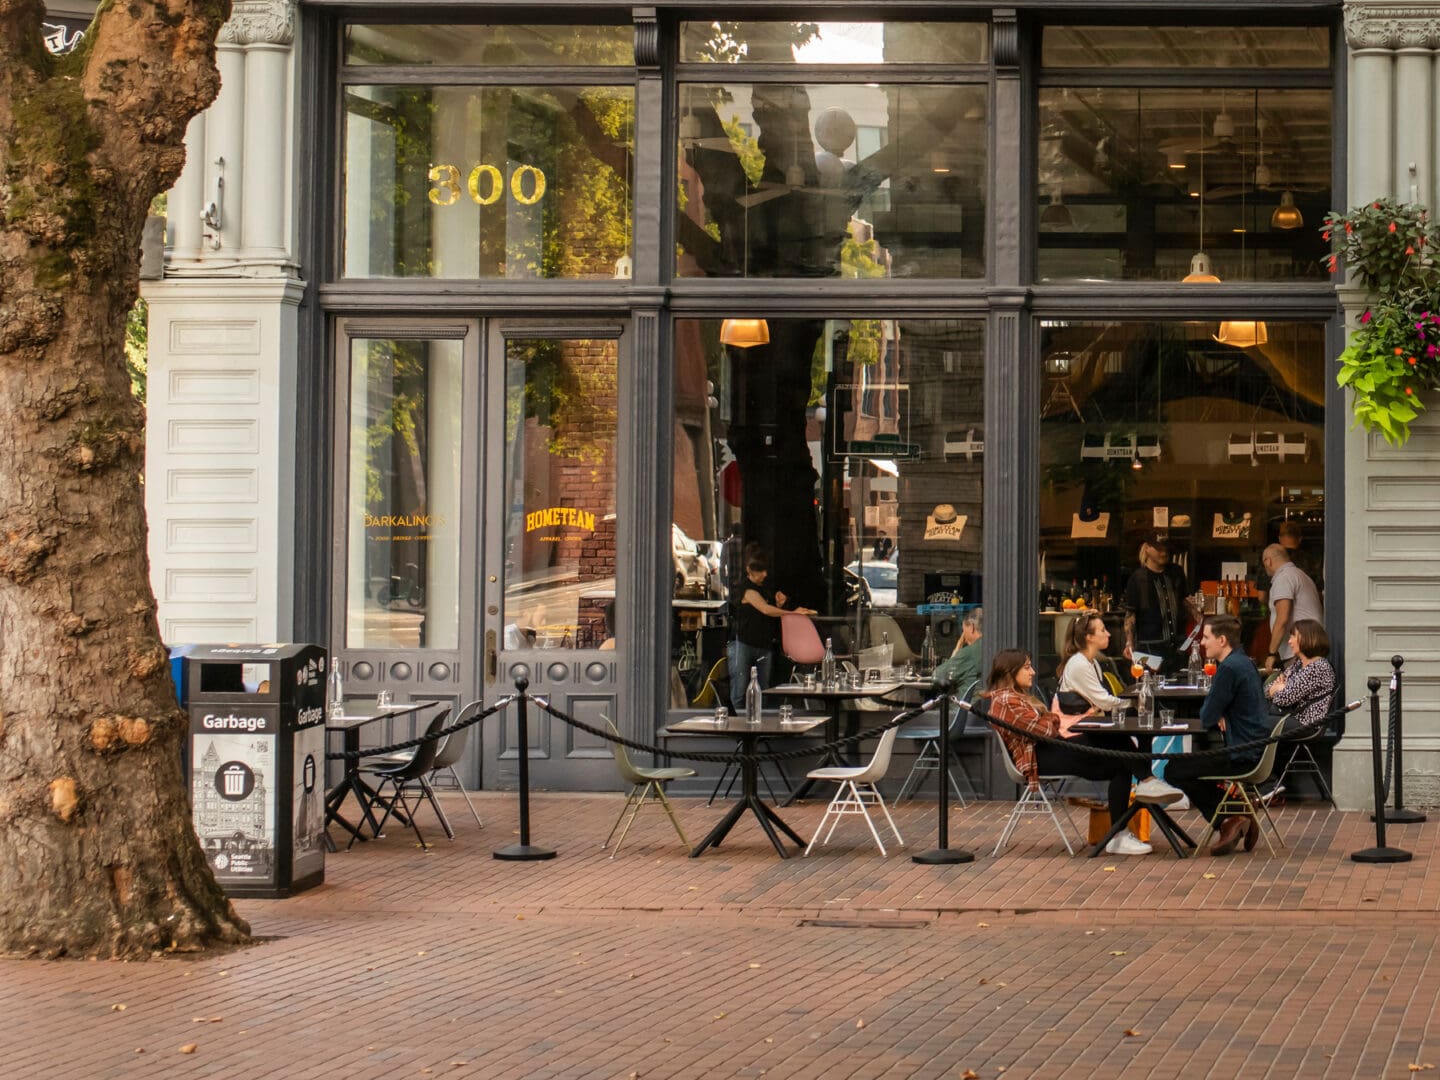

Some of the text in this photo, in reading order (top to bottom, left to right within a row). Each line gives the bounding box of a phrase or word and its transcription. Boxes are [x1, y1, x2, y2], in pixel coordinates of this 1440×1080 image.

[428, 163, 547, 206] 300
[526, 507, 595, 532] HOMETEAM
[203, 714, 266, 731] Garbage
[298, 706, 323, 726] Garbage
